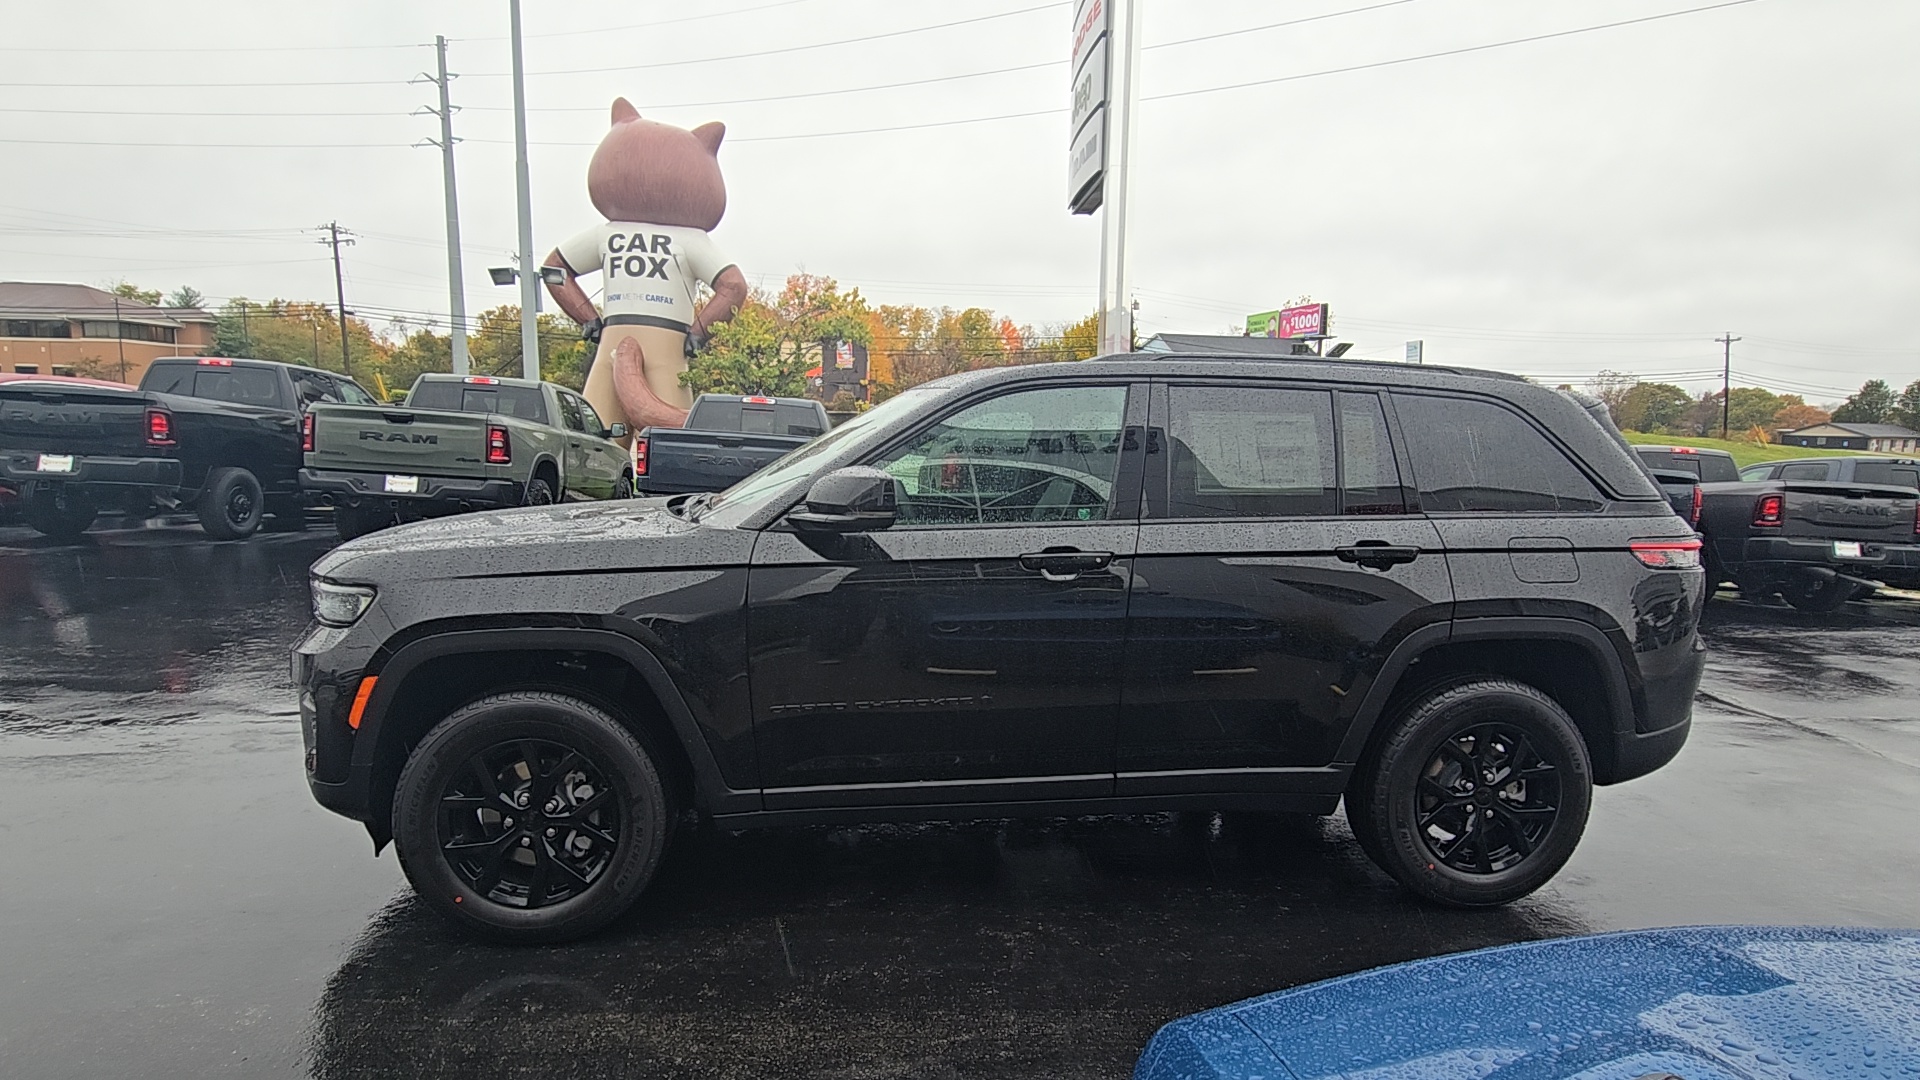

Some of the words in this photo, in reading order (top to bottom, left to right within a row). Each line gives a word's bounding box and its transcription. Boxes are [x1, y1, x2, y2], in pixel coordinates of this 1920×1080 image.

[607, 232, 673, 256] CAR
[609, 255, 670, 281] FOX
[645, 294, 674, 305] CARFAX
[1290, 312, 1319, 330] $1000
[359, 430, 438, 445] RAM
